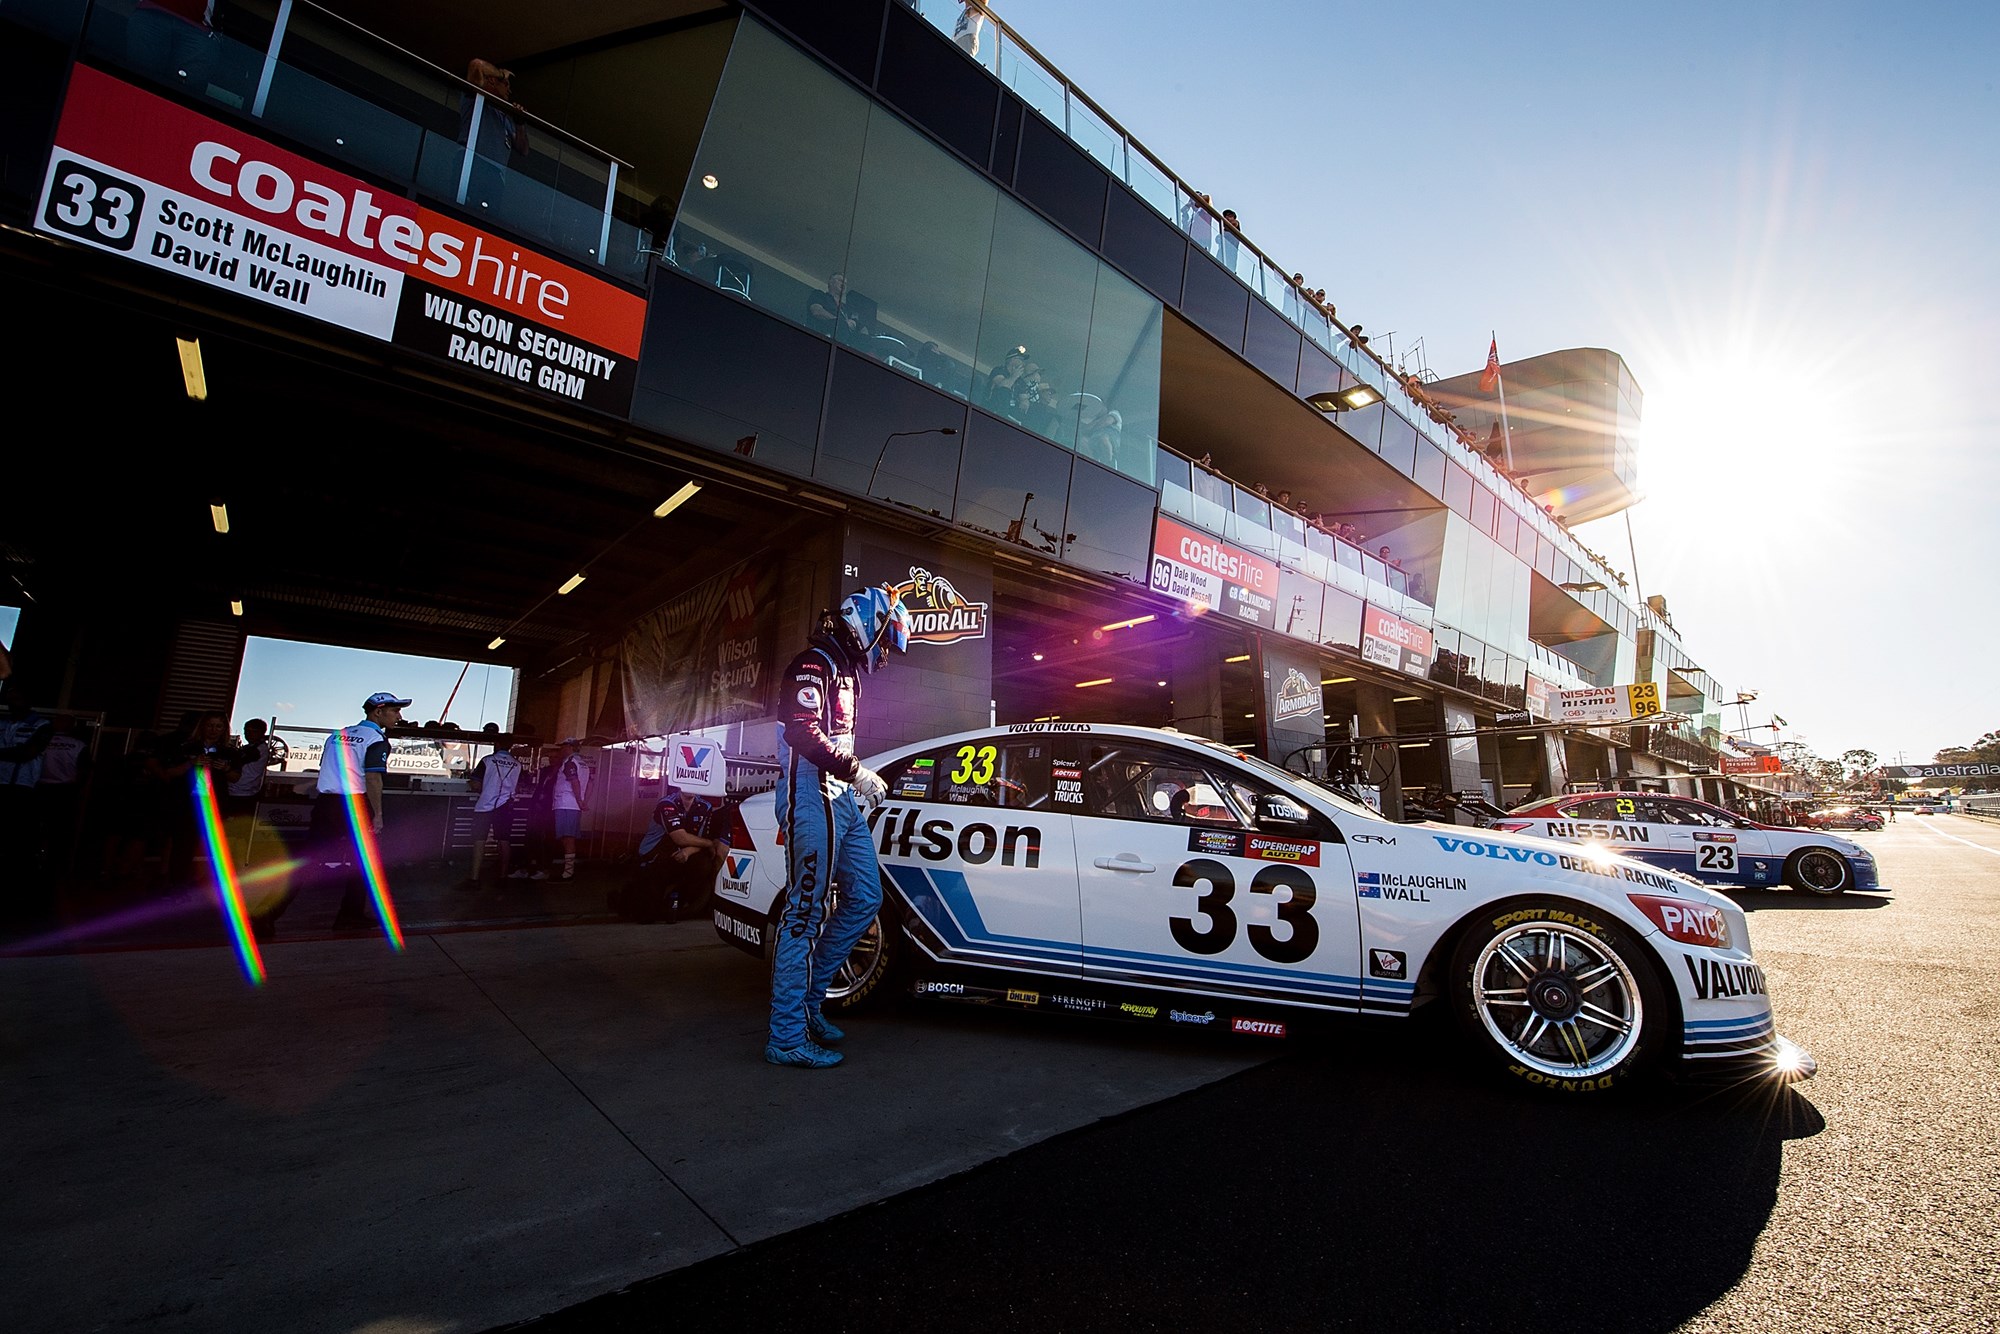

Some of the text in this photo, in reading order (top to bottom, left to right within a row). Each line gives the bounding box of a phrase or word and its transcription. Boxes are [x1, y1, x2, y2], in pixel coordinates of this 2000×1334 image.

[56, 173, 134, 240] 33
[158, 199, 388, 299] Scott McLaughlin
[150, 231, 311, 306] David Wall
[424, 292, 617, 381] WILSON SECURITY
[448, 333, 586, 400] RACING GRM
[844, 564, 859, 578] 21
[1154, 562, 1170, 589] 96
[1174, 566, 1207, 588] Dale Wood
[1171, 581, 1190, 597] David
[909, 608, 979, 633] MORALL
[718, 636, 758, 666] Wilson
[1364, 639, 1374, 657] 23
[711, 660, 761, 693] Security
[1560, 687, 1615, 699] NISSAN
[1633, 685, 1656, 699] 23
[1635, 700, 1658, 714] 96
[1008, 723, 1091, 733] VOLVO TRUCKS
[333, 734, 365, 744] VOLVO
[676, 765, 710, 783] VALVOLINE
[951, 745, 998, 785] 33
[1054, 769, 1080, 777] LOCTITE
[1924, 763, 2000, 777] australia
[1057, 780, 1081, 792] VOLVO
[1054, 791, 1084, 804] TRUCKS
[1616, 799, 1635, 814] 23
[1352, 834, 1397, 846] GRM
[1546, 822, 1649, 843] NISSAN
[1250, 839, 1316, 856] SUPERCHEAP
[1266, 851, 1296, 859] AUTO
[1432, 835, 1679, 894] VOLVO DEALER RACING
[1699, 844, 1734, 870] 23
[722, 876, 750, 896] VALVOLINE
[1381, 873, 1467, 891] McLAUGHLIN
[789, 850, 818, 938] VOLVO
[1382, 887, 1431, 903] WALL
[1169, 858, 1320, 964] 33
[713, 908, 761, 946] VOLVO TRUCKS
[1492, 909, 1604, 935] SPORT MAXX
[927, 982, 964, 994] BOSCH
[1009, 989, 1037, 1003] ÖHLINS
[1052, 994, 1106, 1009] SERENGETI
[1120, 1002, 1159, 1016] REVOLUTION
[1170, 1009, 1209, 1024] Spicers
[1235, 1019, 1283, 1035] LOCTITE
[1508, 1064, 1614, 1092] DUNLOP
